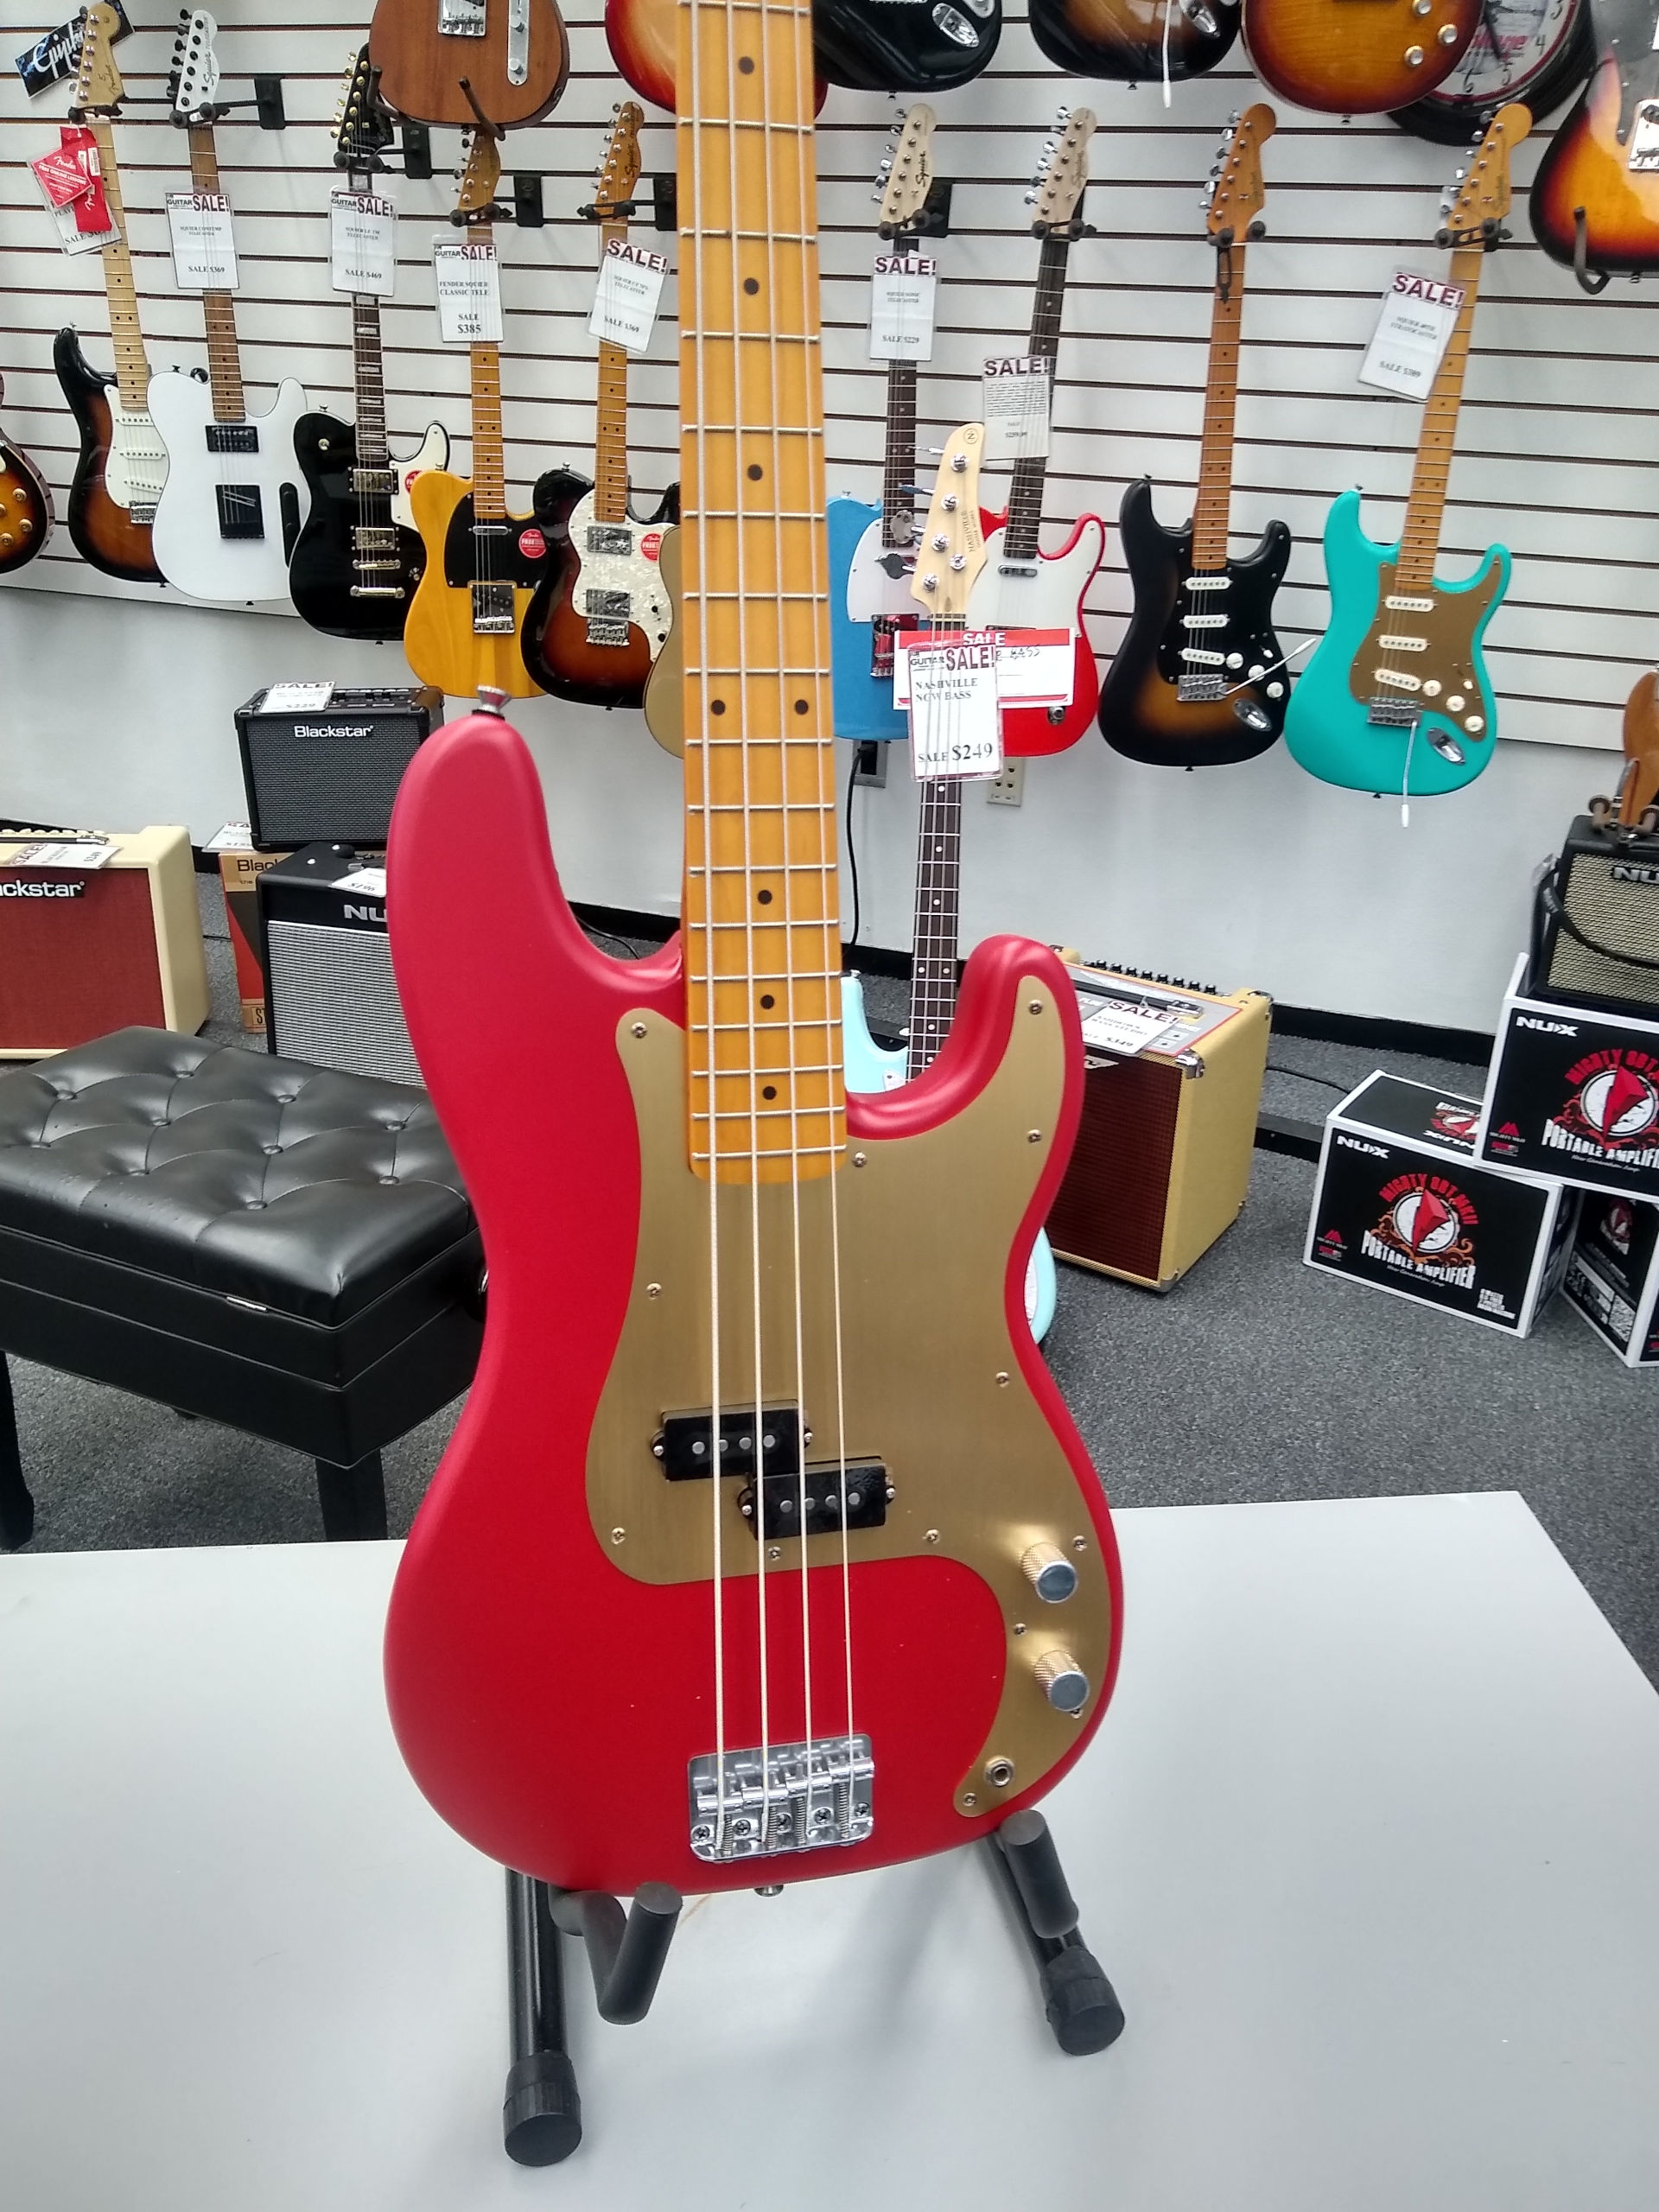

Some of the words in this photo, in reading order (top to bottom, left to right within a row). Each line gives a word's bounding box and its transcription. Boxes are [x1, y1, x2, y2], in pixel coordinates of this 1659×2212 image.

[33, 22, 85, 79] Epiph
[203, 52, 217, 86] Squier
[915, 150, 930, 187] Squier
[193, 194, 229, 213] SALE!
[331, 198, 357, 207] GUITAR
[357, 196, 393, 217] SALE!
[64, 232, 86, 244] SALE
[461, 245, 498, 261] SALE!
[607, 239, 667, 273] SALE!
[345, 269, 365, 277] SALE
[875, 257, 937, 276] SALE!
[1393, 274, 1464, 308] SALE!
[457, 324, 481, 334] $385
[604, 315, 622, 327] SALE
[984, 357, 1050, 376] SALE!
[963, 632, 1006, 646] SALE
[945, 645, 995, 671] SALE!
[915, 677, 978, 690] NASHVILLE
[944, 691, 972, 701] BASS
[294, 725, 372, 738] Blackstar
[918, 752, 948, 763] SALE
[951, 742, 993, 761] $249
[237, 858, 277, 871] Blac
[1613, 866, 1659, 885] NU
[0, 880, 82, 897] ckstar
[344, 904, 387, 923] NU
[1109, 1000, 1179, 1025] SALE!
[1516, 1015, 1580, 1037] NUX
[1564, 1048, 1624, 1085] MIGHTY
[1337, 1135, 1390, 1160] NUX
[1541, 1118, 1604, 1158] PORTABLE
[1605, 1147, 1659, 1169] AMPLIFI
[1379, 1173, 1427, 1203] MIGHTY
[1361, 1230, 1415, 1270] PORTABLE
[1415, 1262, 1477, 1290] AMPLIFIER
